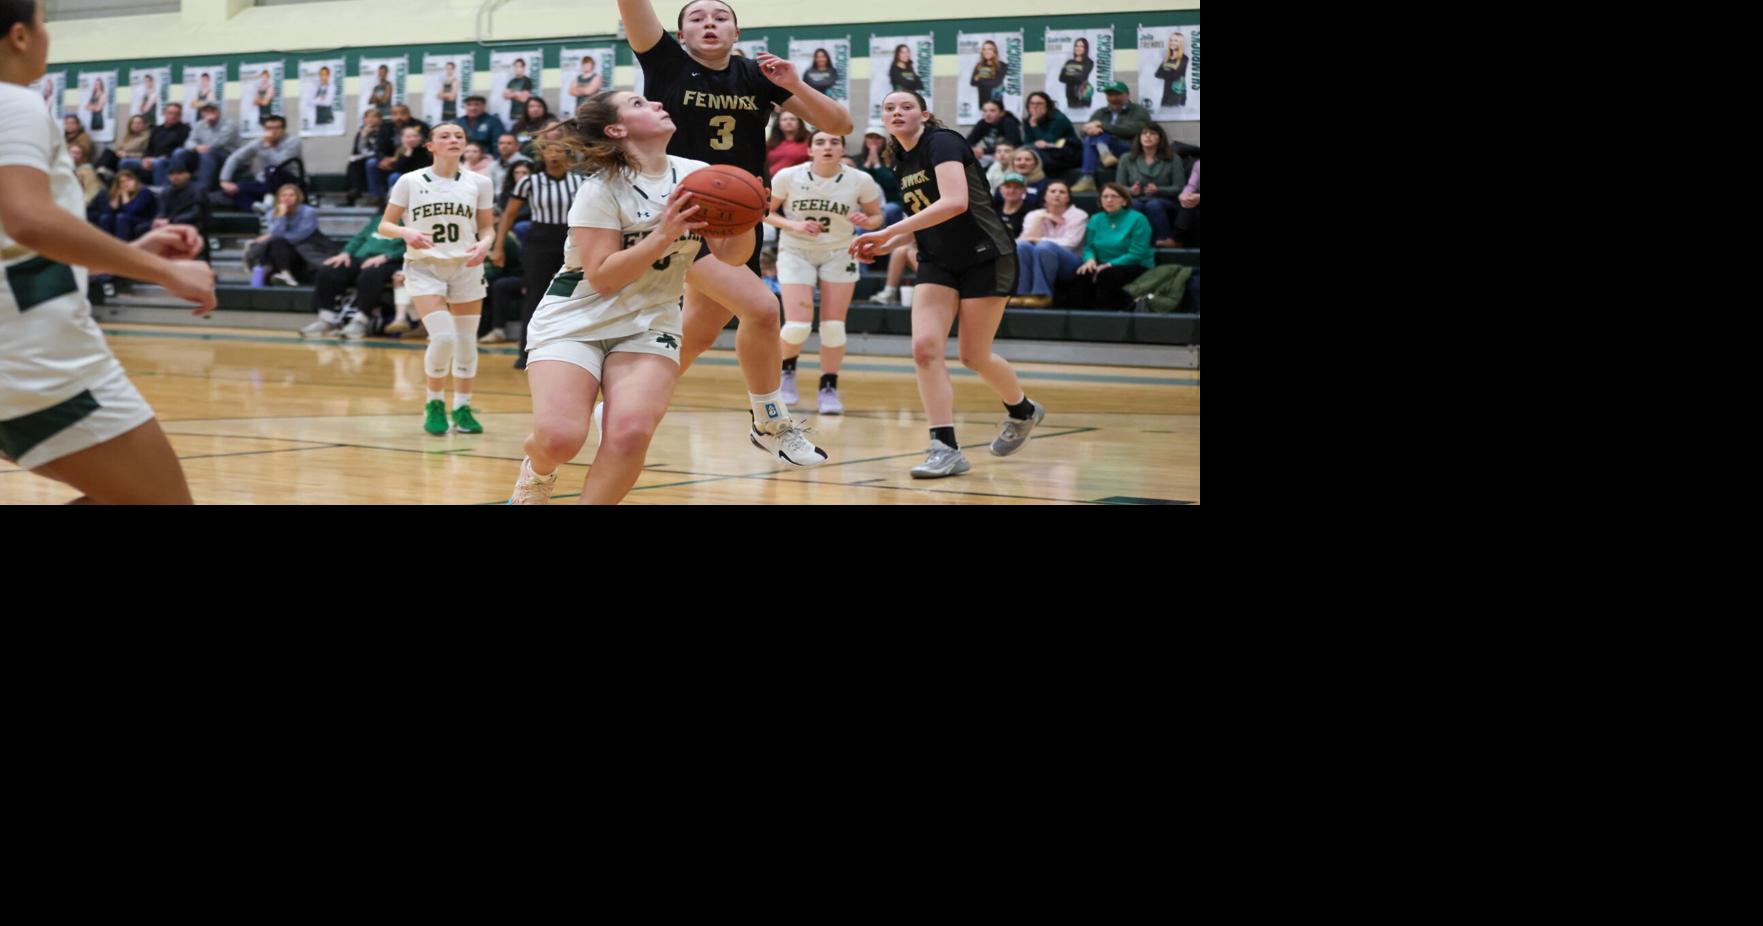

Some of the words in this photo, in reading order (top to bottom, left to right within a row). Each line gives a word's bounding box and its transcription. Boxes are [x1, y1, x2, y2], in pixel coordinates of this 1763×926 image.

[709, 115, 736, 150] 3
[792, 199, 850, 216] FEEHAN
[903, 188, 932, 214] 21
[412, 202, 474, 222] FEEHAN
[432, 223, 460, 243] 20
